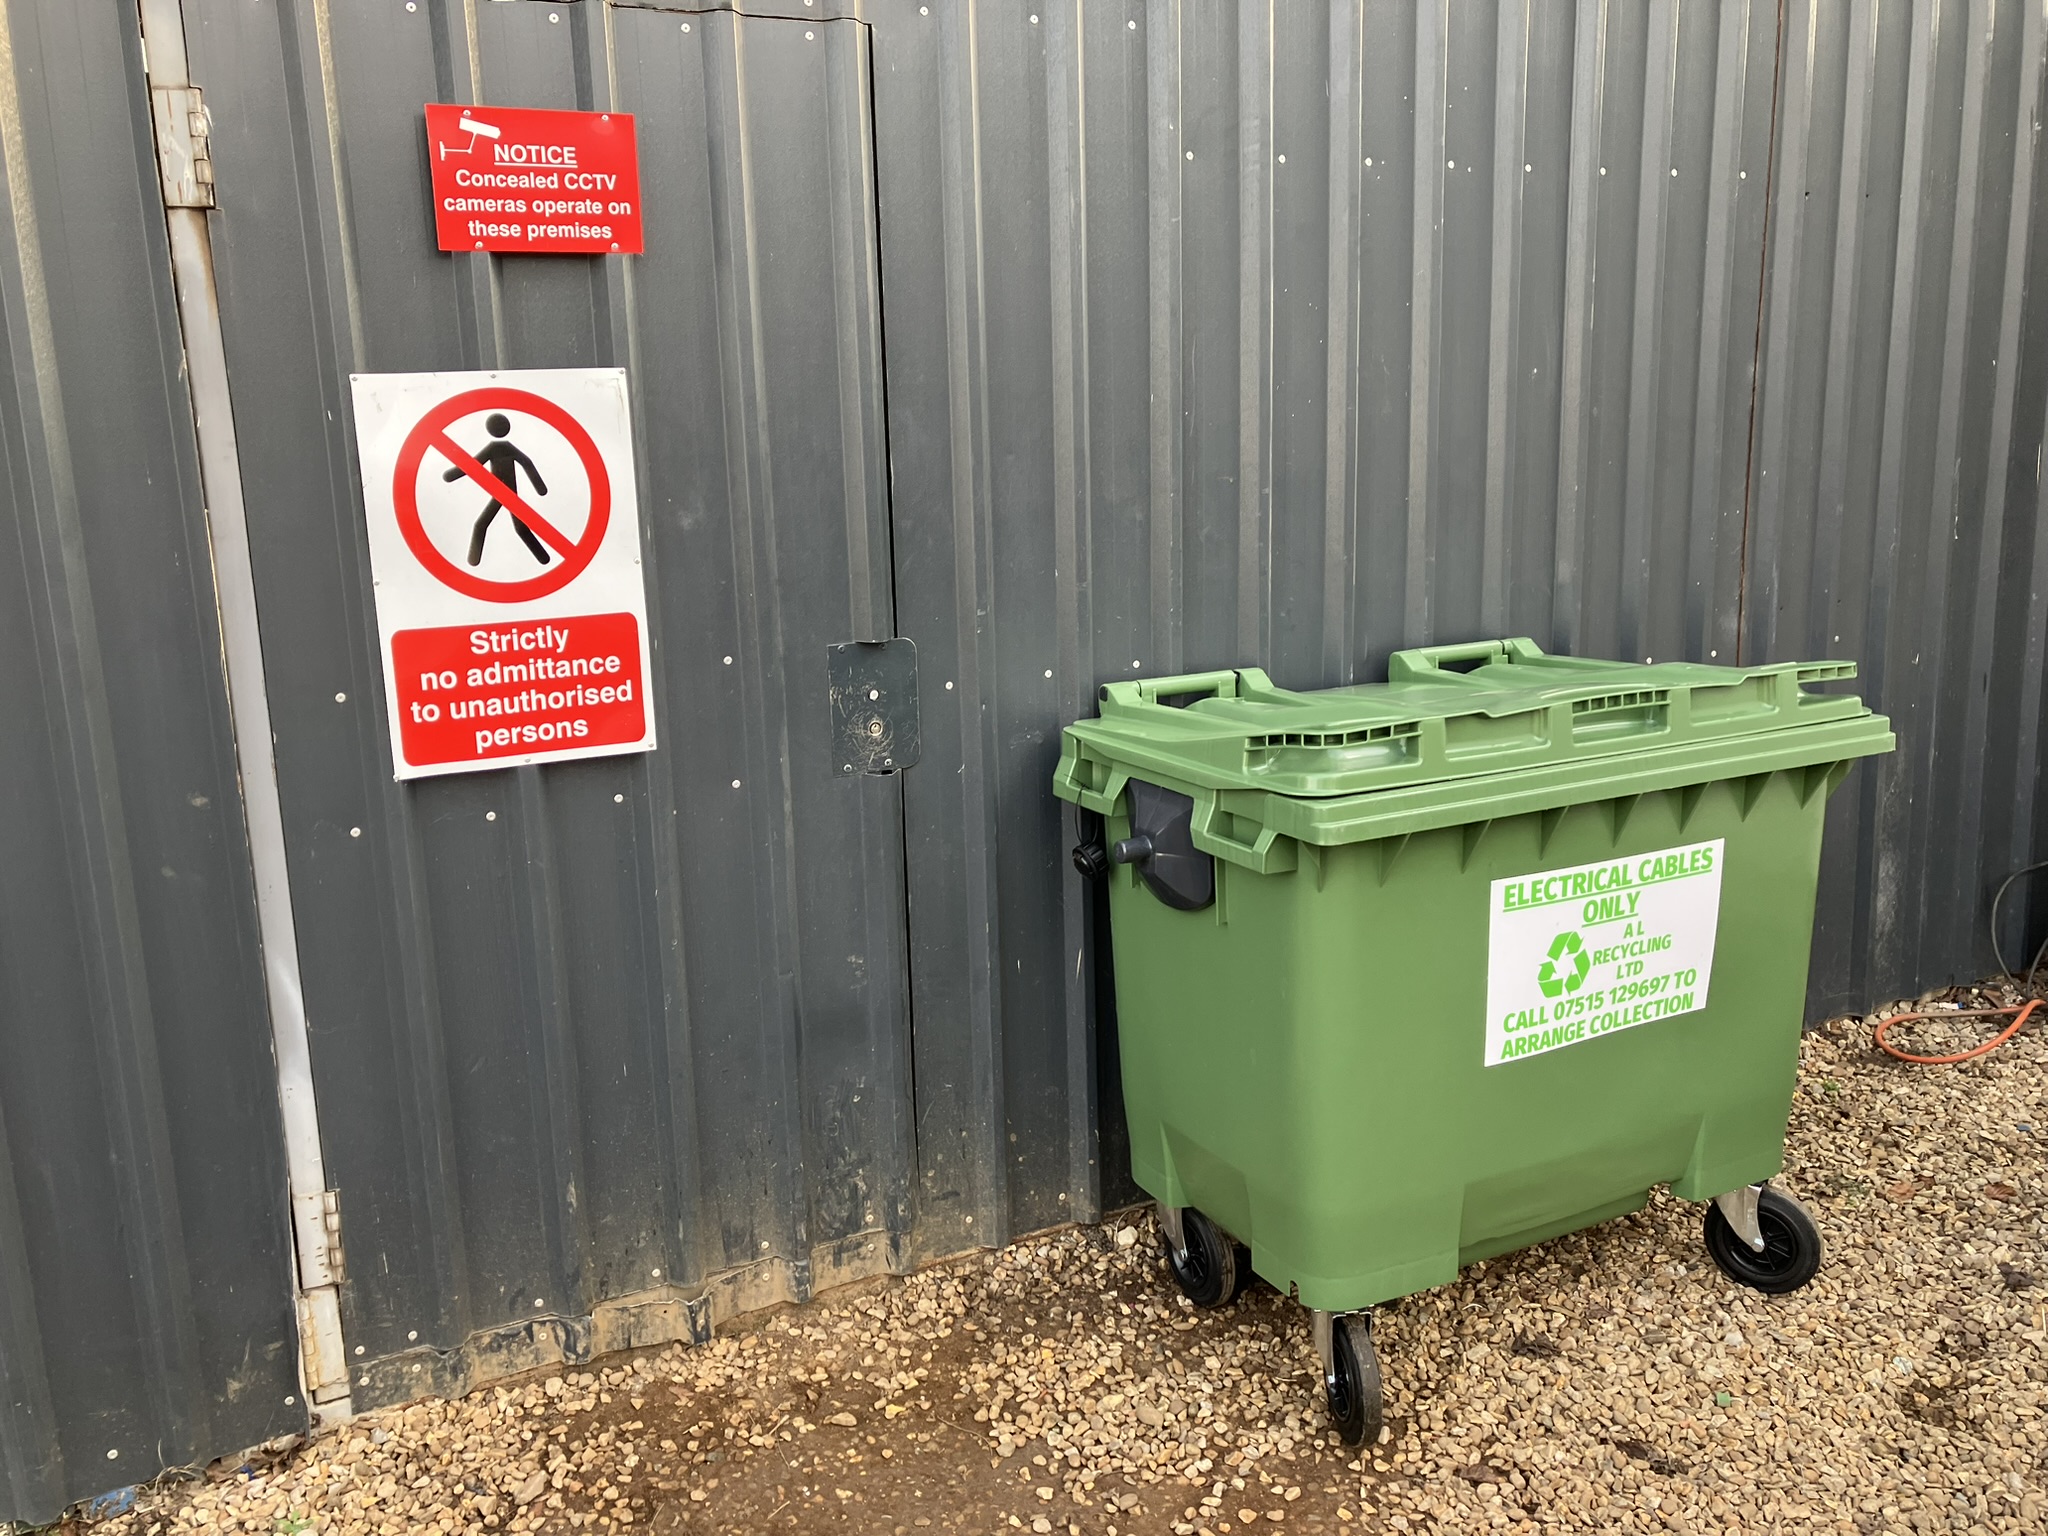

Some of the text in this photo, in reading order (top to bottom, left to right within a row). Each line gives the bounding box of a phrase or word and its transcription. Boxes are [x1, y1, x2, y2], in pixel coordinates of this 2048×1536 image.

[494, 144, 578, 165] NOTICE
[455, 169, 616, 190] Concealed CCTV
[444, 198, 631, 217] cameras operate on
[468, 220, 612, 241] these premises
[470, 625, 569, 654] Strictly
[420, 655, 620, 691] no admittance
[411, 679, 632, 723] to unauthorised
[475, 719, 588, 754] persons
[1504, 847, 1713, 908] ELECTRICAL CABLES
[1583, 891, 1641, 922] ONLY
[1624, 921, 1644, 938] A L
[1593, 934, 1672, 965] RECYCLING
[1616, 960, 1643, 979] LTD
[1503, 968, 1697, 1033] CALL 07515 129697 TO
[1501, 992, 1694, 1060] ARRANGE COLLECTION
